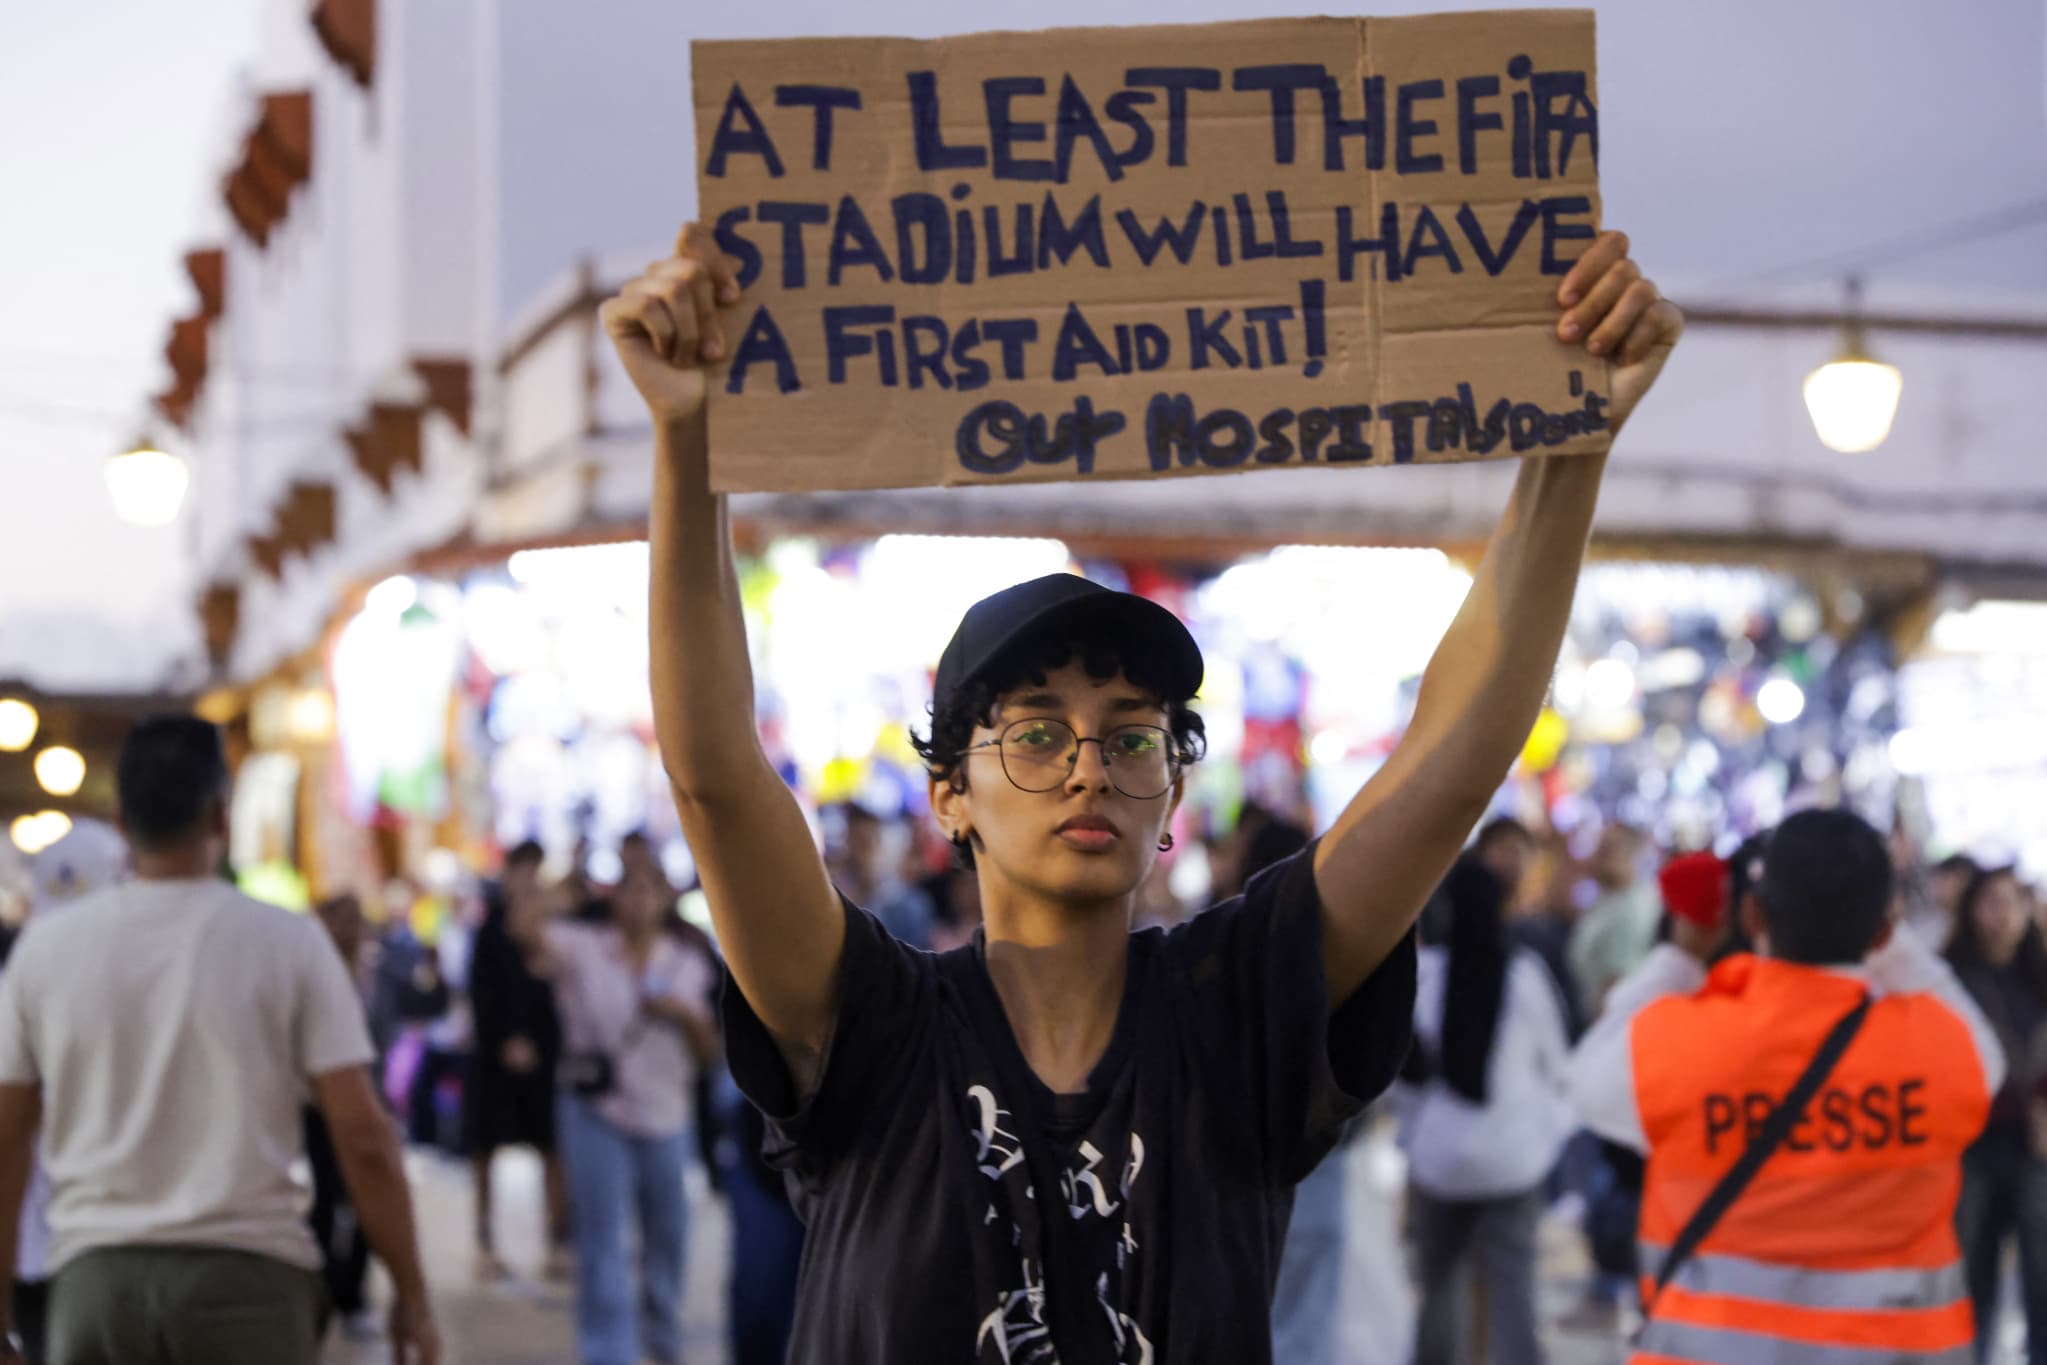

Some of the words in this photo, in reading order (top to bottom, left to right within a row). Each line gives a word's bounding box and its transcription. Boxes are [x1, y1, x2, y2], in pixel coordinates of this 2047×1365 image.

[705, 81, 862, 178] AT
[907, 67, 1222, 184] LEAST
[1232, 63, 1445, 174] THE
[1115, 190, 1324, 267] WILL
[1335, 196, 1597, 282] HAVE
[726, 304, 803, 395] A
[1052, 301, 1171, 382] AID
